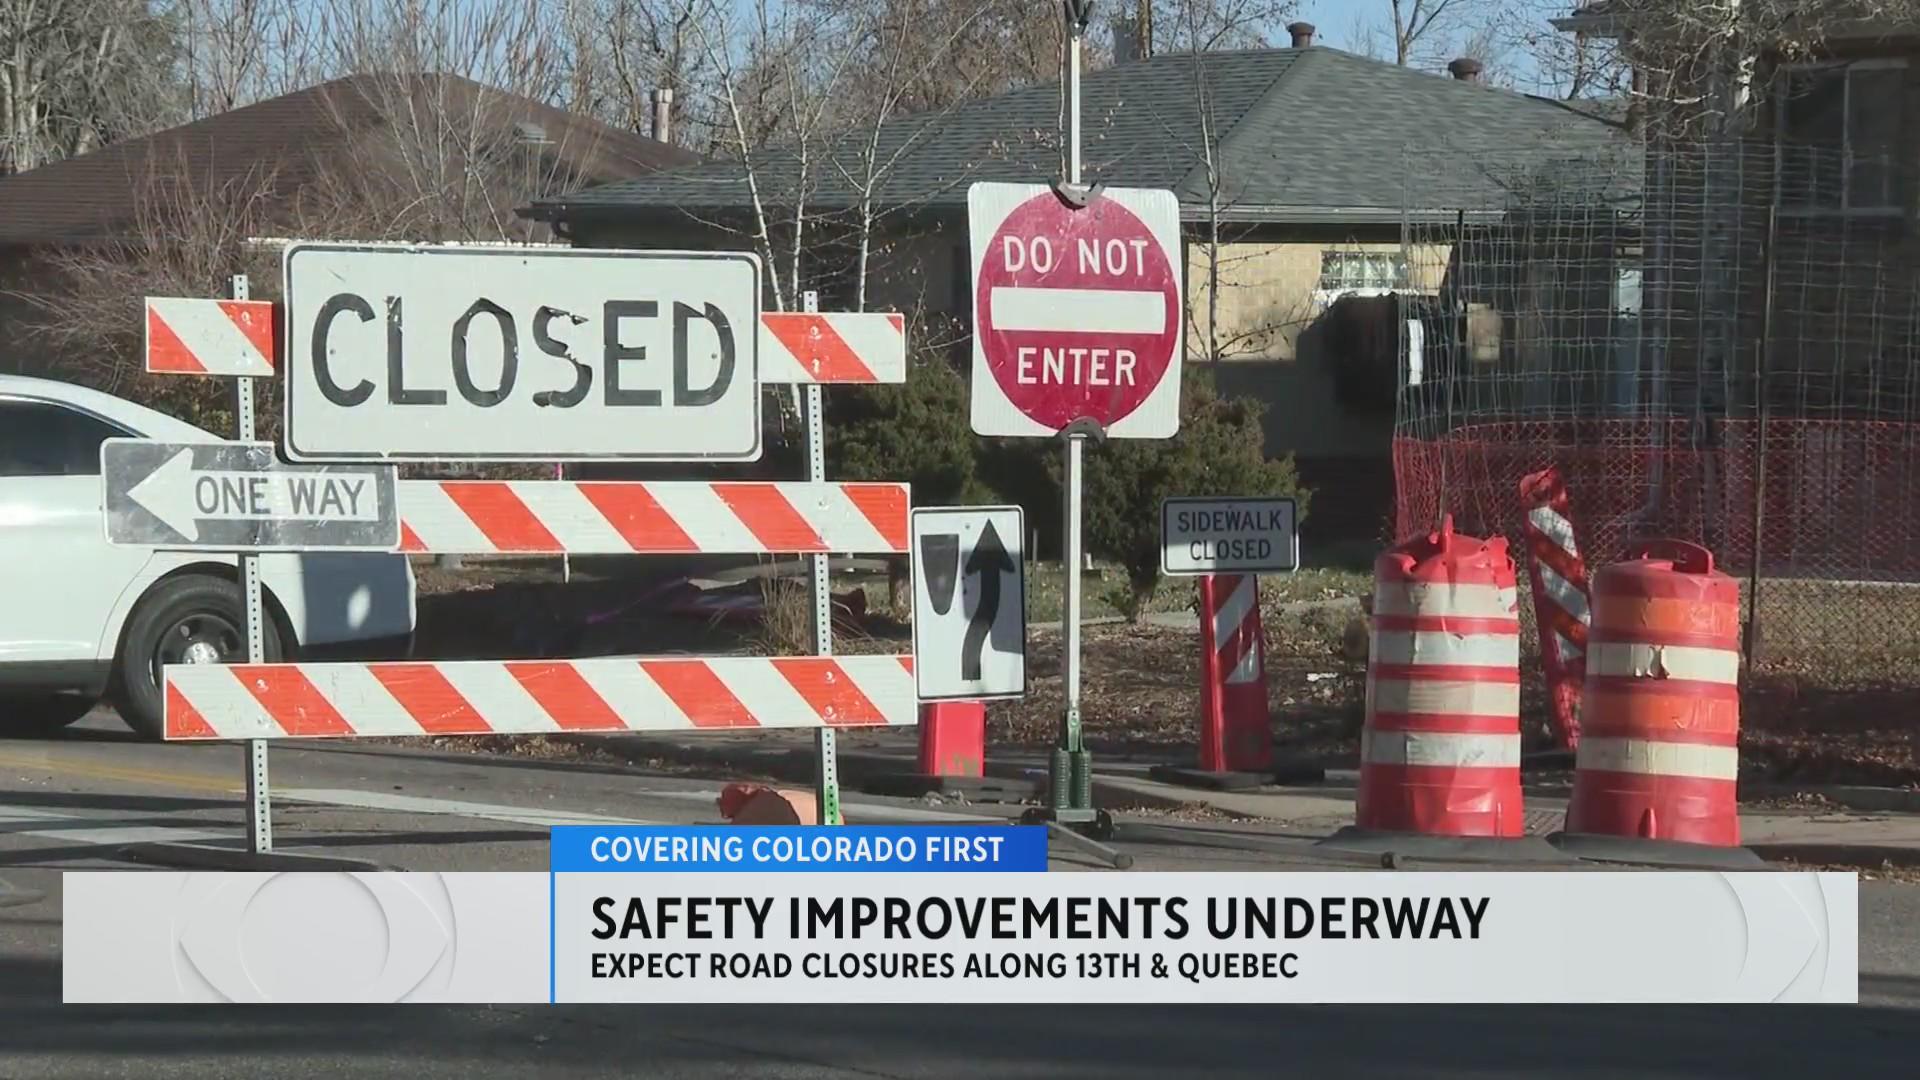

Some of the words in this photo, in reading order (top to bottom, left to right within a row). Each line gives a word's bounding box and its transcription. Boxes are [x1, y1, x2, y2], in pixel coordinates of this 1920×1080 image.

[1003, 236, 1052, 274] DO
[1078, 239, 1149, 277] NOT
[311, 293, 736, 408] CLOSED
[1017, 347, 1136, 387] ENTER
[195, 476, 271, 516] ONE
[287, 478, 365, 516] WAY
[1177, 509, 1282, 533] SIDEWALK
[1190, 539, 1272, 561] CLOSED
